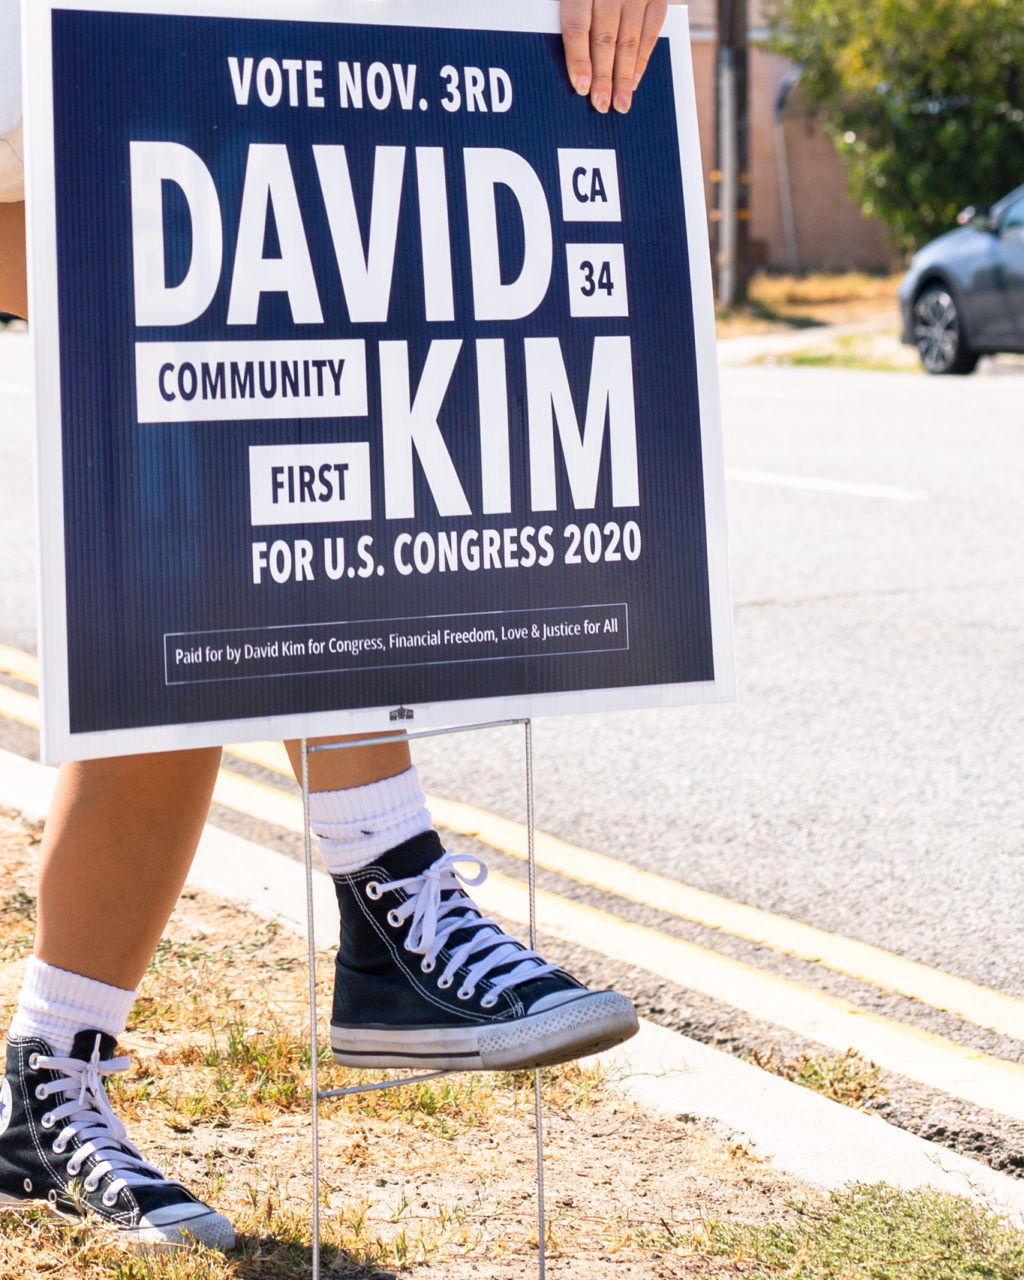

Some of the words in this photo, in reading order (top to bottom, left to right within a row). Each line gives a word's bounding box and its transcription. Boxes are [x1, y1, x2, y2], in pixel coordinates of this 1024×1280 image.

[228, 57, 324, 107] VOTE
[339, 62, 427, 111] NOV.
[440, 65, 512, 112] 3RD
[573, 167, 607, 203] CA
[130, 141, 552, 326] DAVID
[580, 261, 613, 296] 34
[159, 359, 345, 401] COMMUNITY
[379, 336, 639, 519] KIM
[272, 463, 348, 503] FIRST
[252, 540, 314, 584] FOR
[324, 535, 384, 579] U.S.
[394, 525, 554, 575] CONGRESS
[564, 521, 641, 564] 2020
[176, 647, 202, 664] Paid
[206, 646, 223, 662] for
[227, 645, 241, 664] by
[245, 641, 278, 659] David
[282, 641, 305, 656] Kim
[308, 639, 325, 654] for
[329, 638, 385, 655] Congress,
[390, 630, 440, 648] Financial
[444, 628, 498, 644] Freedom,
[502, 626, 528, 640] Love
[531, 624, 540, 638] &
[542, 622, 580, 640] Justice
[584, 620, 600, 634] for
[604, 618, 617, 633] All
